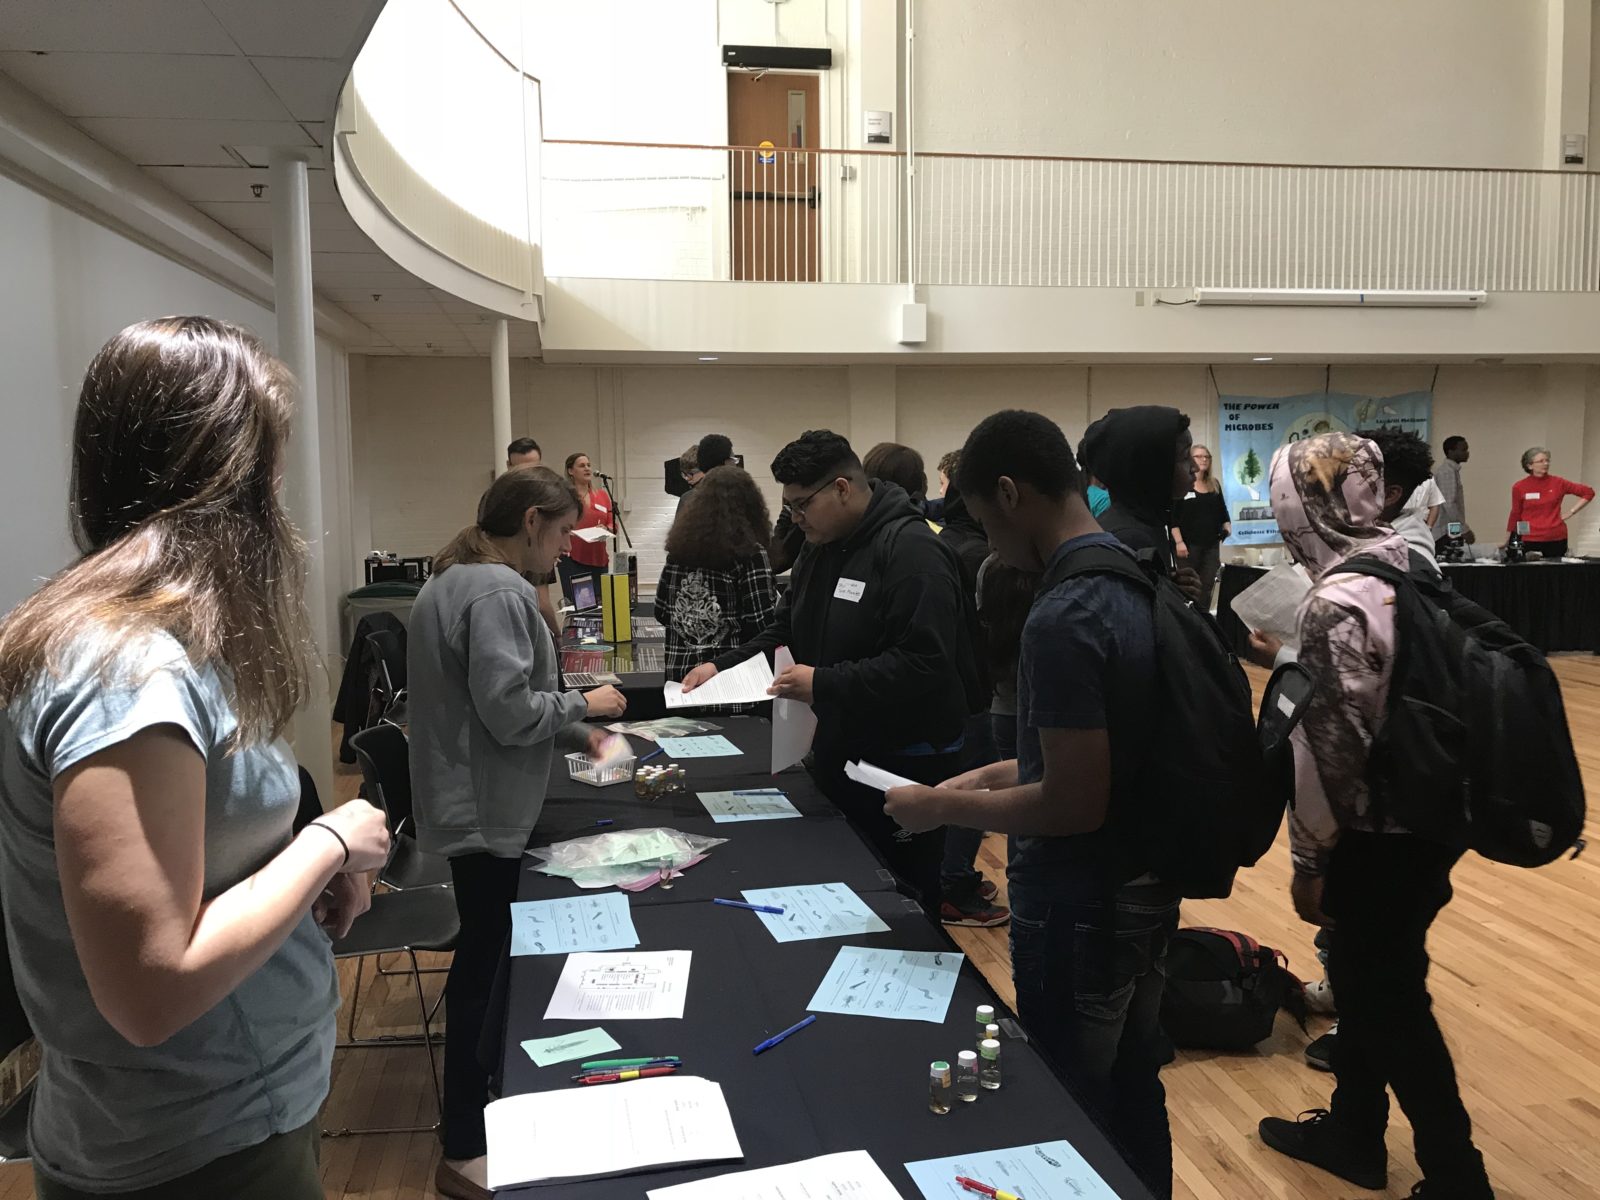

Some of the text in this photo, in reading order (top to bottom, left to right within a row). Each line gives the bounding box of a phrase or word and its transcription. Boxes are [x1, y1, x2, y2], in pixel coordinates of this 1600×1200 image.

[1223, 402, 1280, 410] THE POWER
[1225, 423, 1274, 431] MICROBES
